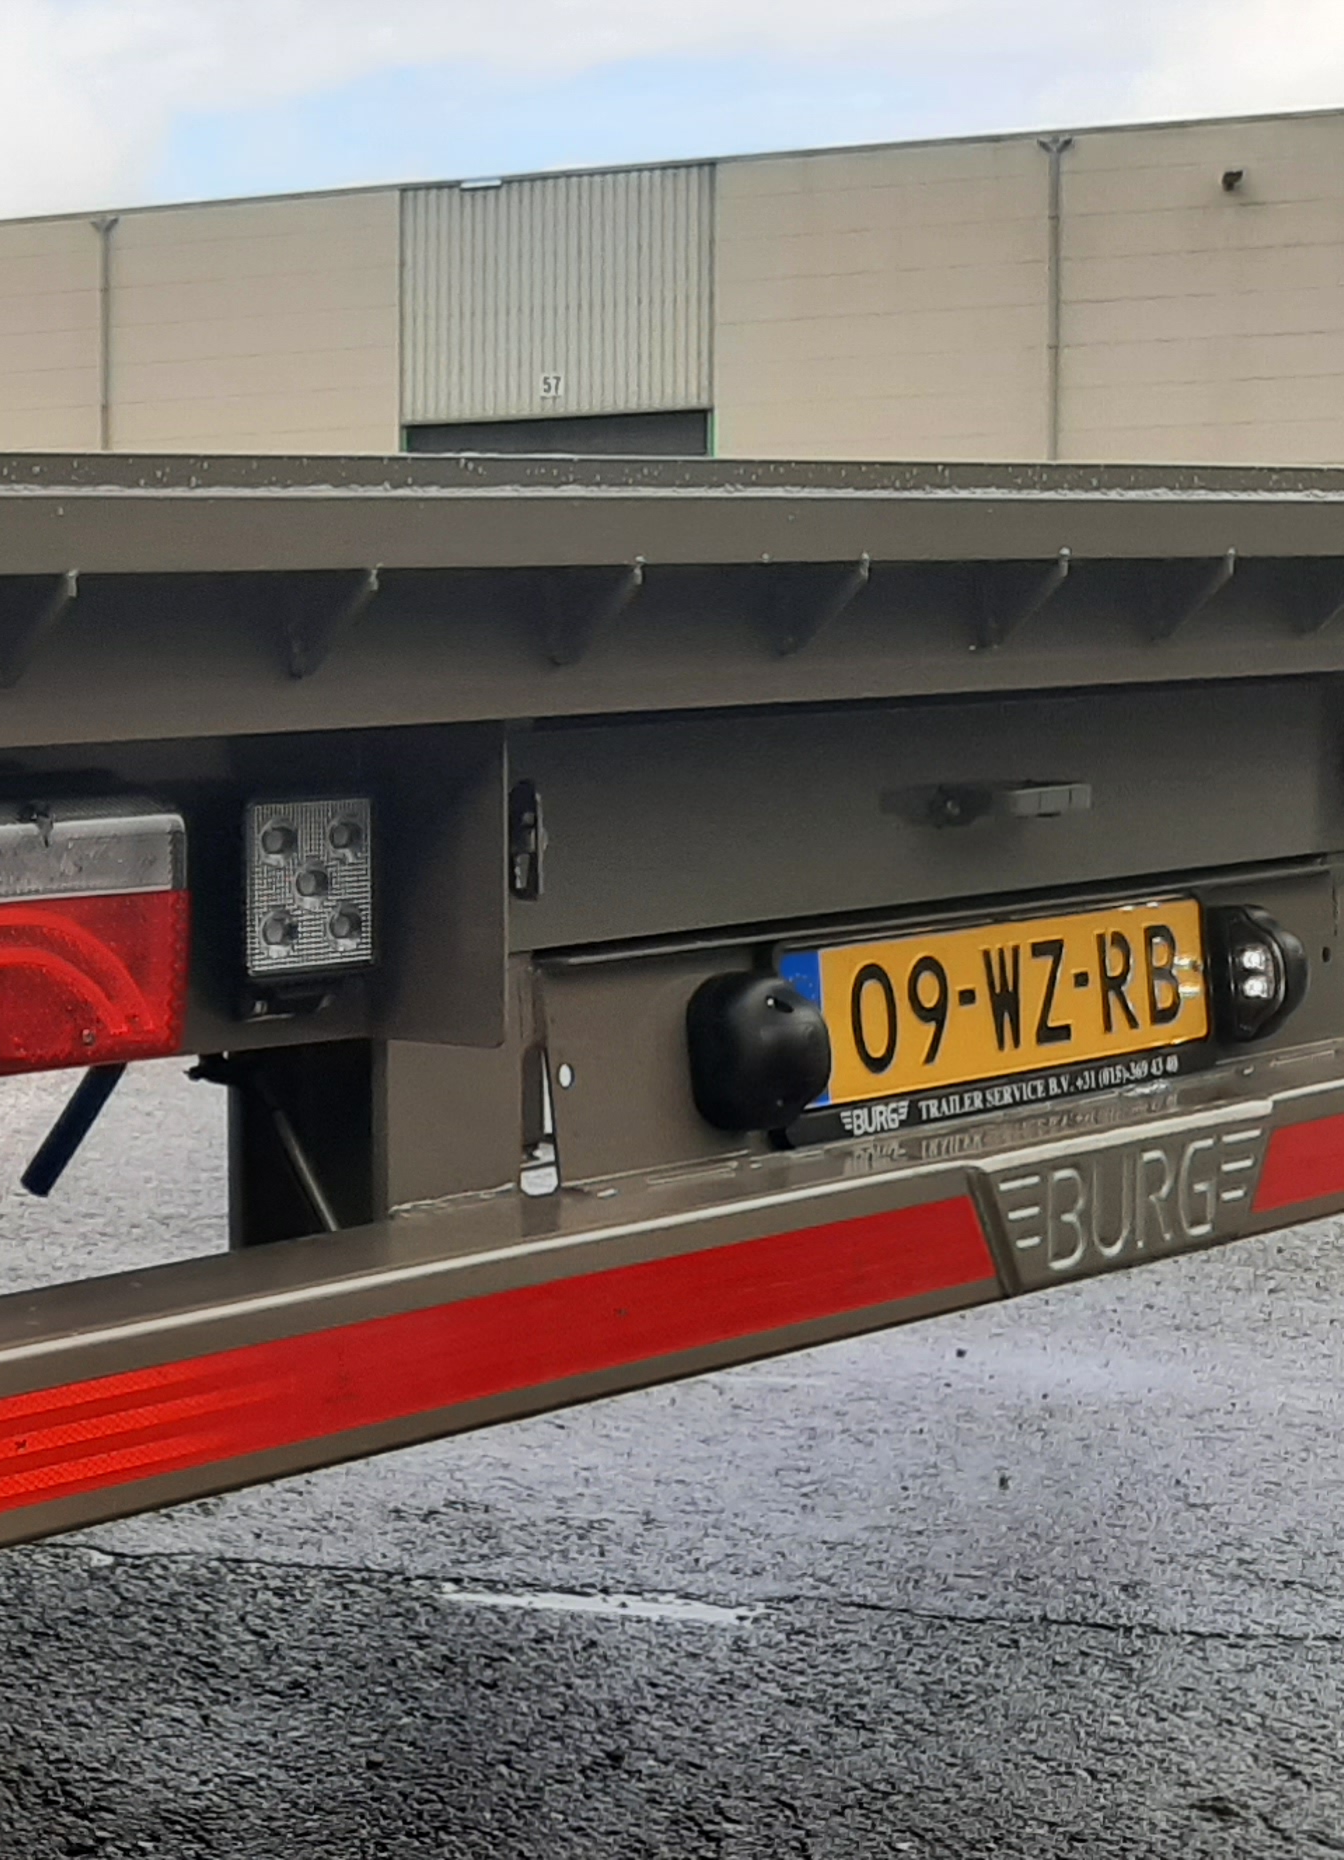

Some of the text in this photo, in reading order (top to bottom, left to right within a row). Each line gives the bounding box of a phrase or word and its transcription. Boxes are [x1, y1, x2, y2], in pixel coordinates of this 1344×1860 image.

[542, 376, 561, 396] 57
[850, 924, 1182, 1074] 09-WZ-RB
[852, 1102, 900, 1136] BURG
[918, 1091, 983, 1121] TRAILER
[984, 1079, 1046, 1108] SERVICE
[1048, 1073, 1075, 1096] B.V.
[1075, 1070, 1097, 1091] +31
[1046, 1136, 1215, 1272] BURG
